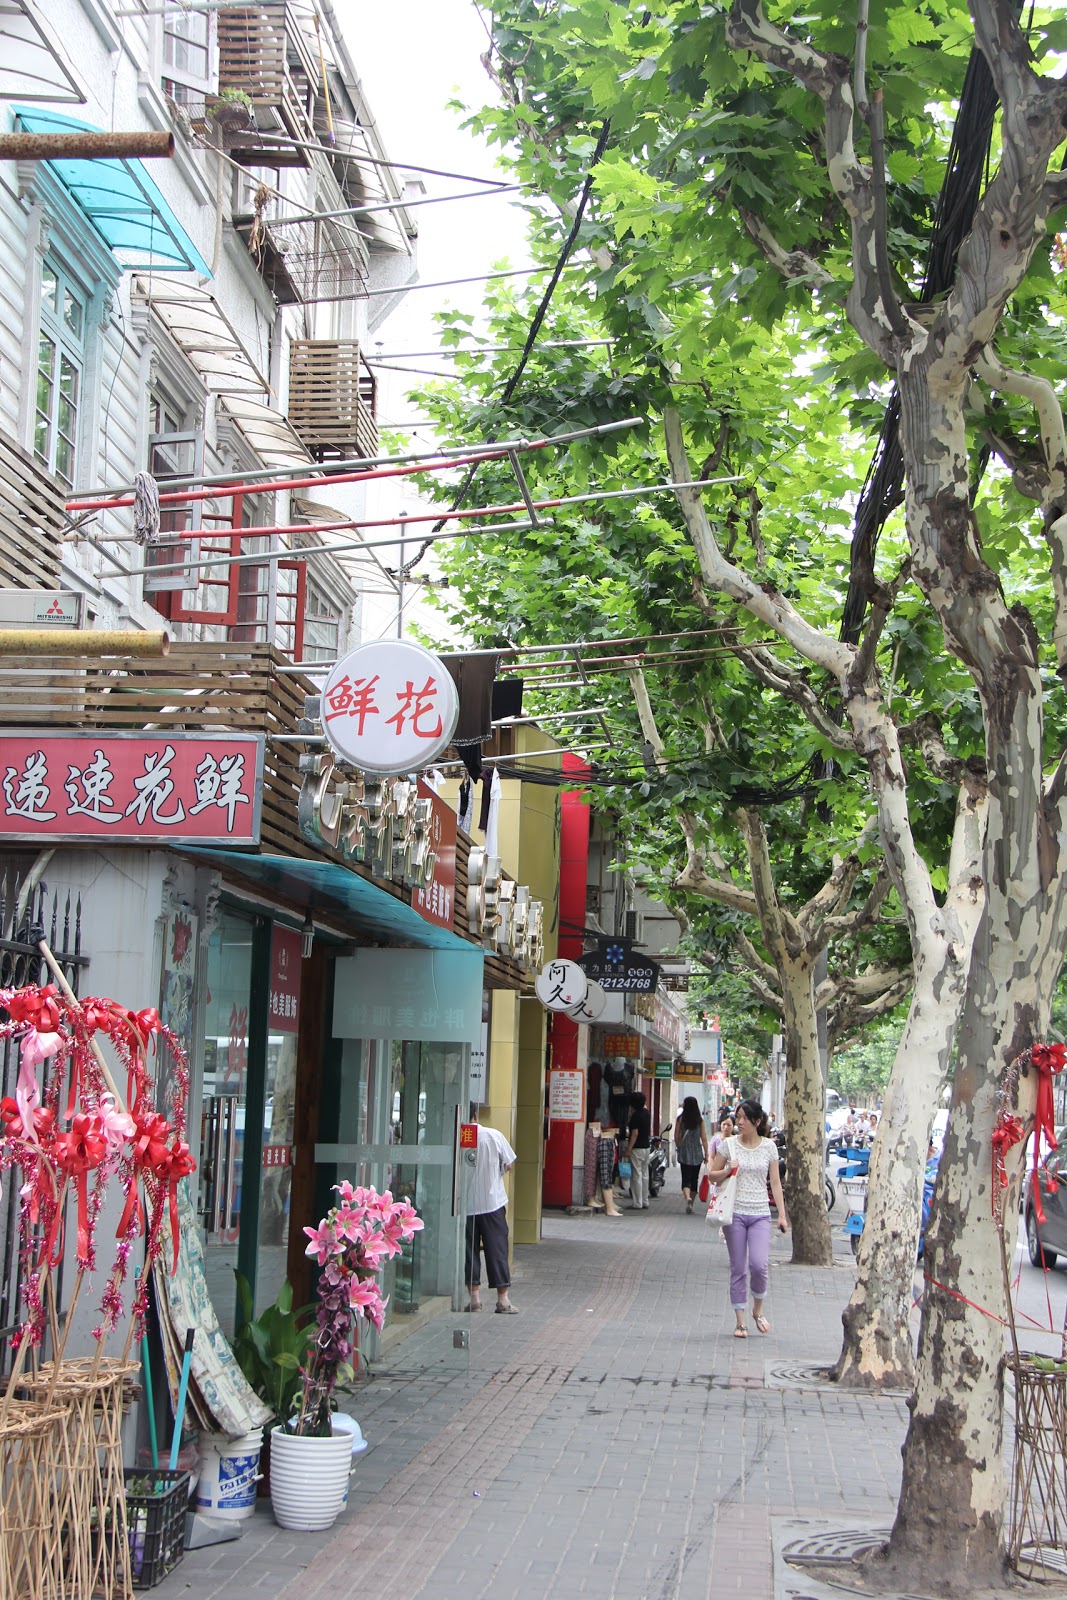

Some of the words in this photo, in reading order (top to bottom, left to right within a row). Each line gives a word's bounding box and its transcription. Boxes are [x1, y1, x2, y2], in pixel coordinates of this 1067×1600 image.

[325, 674, 443, 738] 鲜花
[546, 962, 573, 1005] 阿久
[598, 977, 651, 989] 62124768
